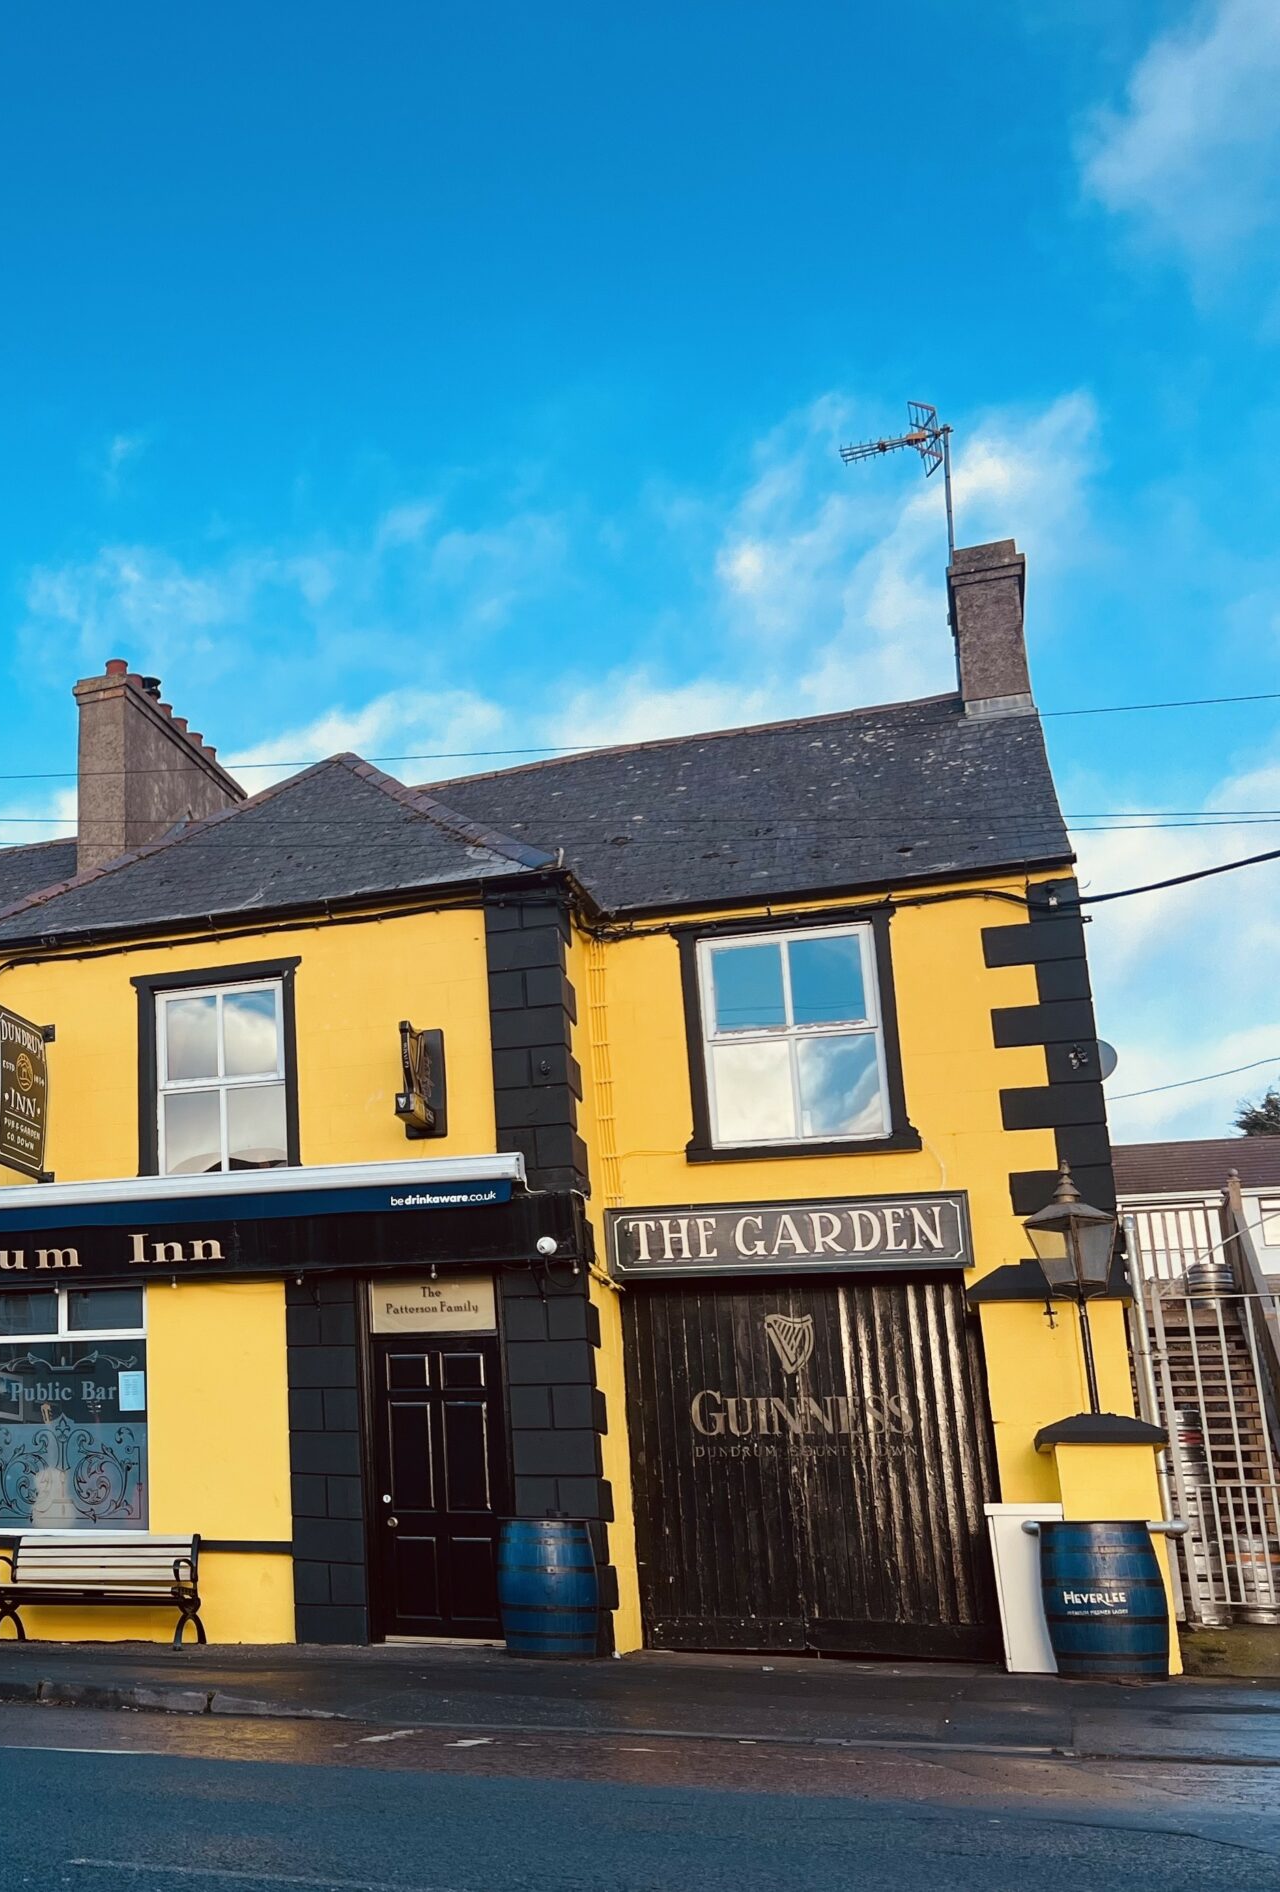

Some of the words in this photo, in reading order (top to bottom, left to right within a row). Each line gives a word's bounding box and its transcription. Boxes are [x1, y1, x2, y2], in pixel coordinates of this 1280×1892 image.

[1, 1019, 45, 1062] DUNDRUM
[10, 1087, 37, 1118] INN
[4, 1117, 15, 1129] PUB
[20, 1124, 40, 1140] GARDEN
[17, 1136, 35, 1151] DOWN
[628, 1217, 718, 1261] THE
[734, 1206, 945, 1257] GARDEN
[127, 1233, 226, 1265] Inn
[421, 1286, 442, 1298] The
[385, 1303, 438, 1315] Patterson
[439, 1300, 479, 1313] Family
[10, 1382, 72, 1402] Public
[81, 1381, 117, 1400] Bar
[691, 1390, 914, 1436] GUINNESS
[695, 1446, 778, 1458] DUNDRUM
[865, 1444, 918, 1457] OWN
[1063, 1591, 1127, 1608] HEVERLEE
